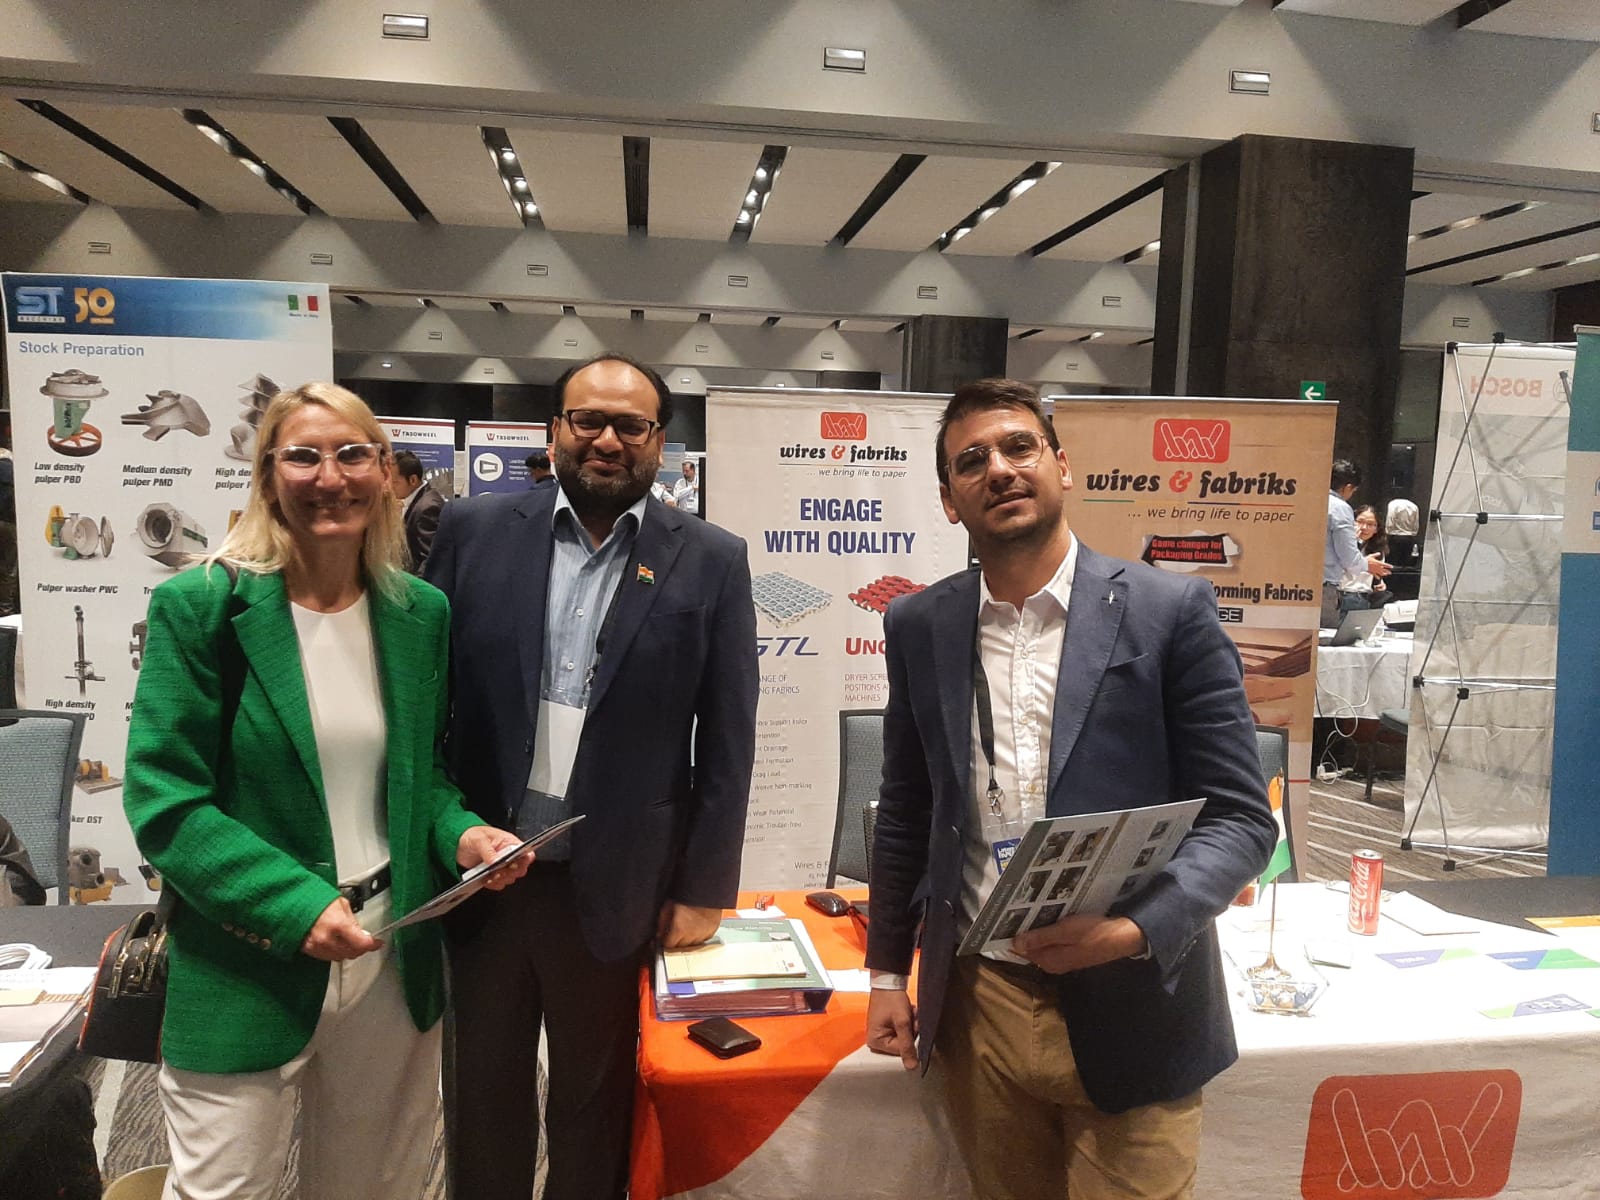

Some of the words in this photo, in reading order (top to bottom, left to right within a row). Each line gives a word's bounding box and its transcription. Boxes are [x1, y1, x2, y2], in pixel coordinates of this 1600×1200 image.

[16, 286, 64, 315] ST
[74, 287, 115, 324] 50
[19, 341, 58, 354] Stock
[63, 342, 144, 357] Preparation
[780, 444, 826, 459] wires
[831, 445, 846, 460] &
[850, 445, 908, 463] fabriks
[34, 462, 52, 472] Low
[54, 463, 85, 474] density
[122, 464, 157, 474] Medium
[158, 465, 192, 477] density
[216, 467, 236, 478] High
[833, 468, 855, 478] bring
[858, 468, 870, 477] life
[872, 469, 880, 477] to
[882, 470, 908, 478] paper
[34, 474, 61, 485] pulper
[122, 476, 150, 488] pulper
[152, 478, 173, 487] PMD
[214, 480, 244, 490] pulper
[1086, 469, 1160, 492] wires
[1168, 470, 1193, 492] &
[1199, 470, 1297, 498] fabriks
[800, 498, 882, 522] ENGAGE
[1148, 508, 1166, 518] we
[1171, 507, 1206, 522] bring
[1210, 507, 1230, 520] life
[1236, 510, 1250, 520] to
[1254, 511, 1295, 524] paper
[764, 530, 820, 552] WITH
[827, 531, 916, 556] QUALITY
[1152, 539, 1176, 548] Game
[1176, 540, 1210, 550] changer
[1210, 540, 1222, 549] for
[1151, 550, 1193, 560] Packaging
[1194, 551, 1222, 560] Grades
[37, 583, 64, 593] Pulper
[66, 584, 97, 593] washer
[99, 585, 118, 594] PWC
[1211, 581, 1260, 603] orming
[1264, 584, 1314, 601] Fabrics
[772, 686, 800, 694] FABRICS
[844, 684, 880, 692] POSITIONS
[45, 698, 64, 709] High
[66, 700, 96, 710] density
[844, 694, 881, 702] MACHINES
[87, 815, 104, 824] DST
